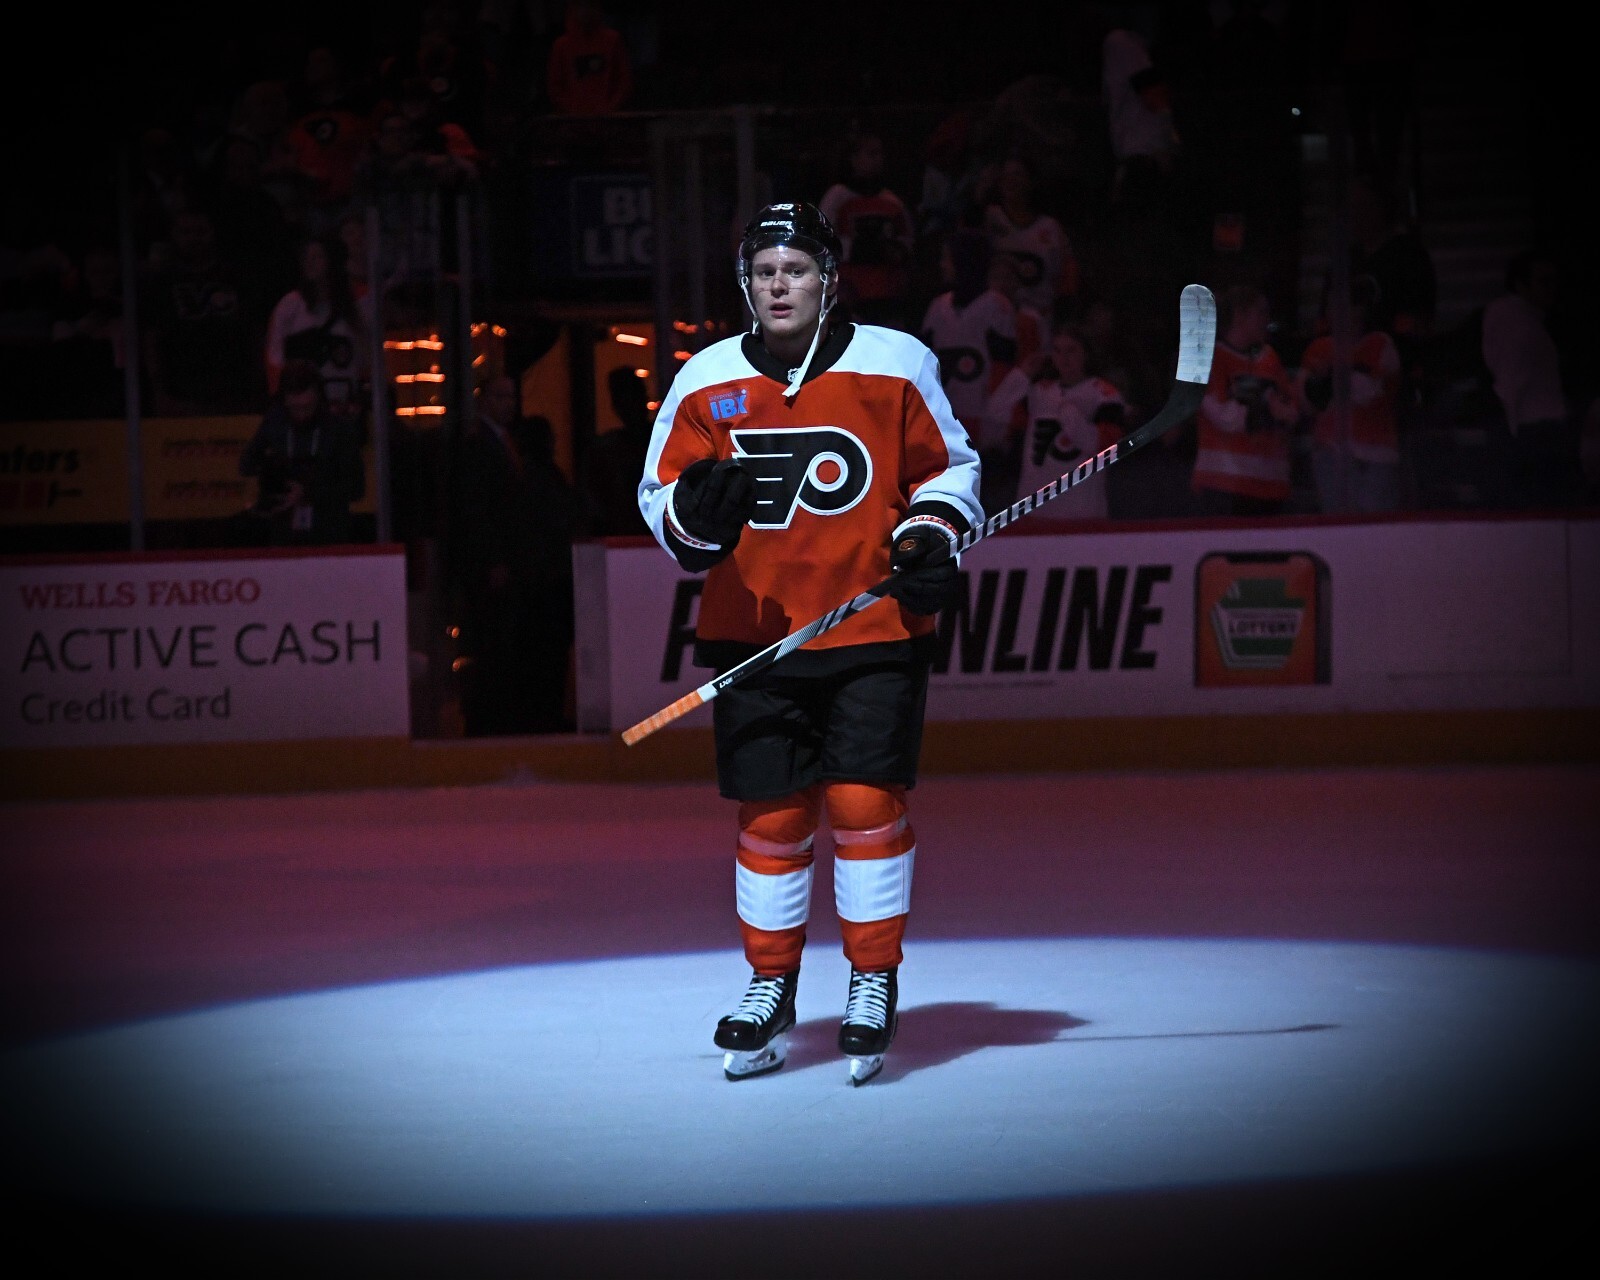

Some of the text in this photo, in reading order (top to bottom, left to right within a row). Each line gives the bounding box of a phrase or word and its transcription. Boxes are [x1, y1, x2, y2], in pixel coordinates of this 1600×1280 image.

[710, 394, 747, 420] IBX
[19, 577, 261, 610] WELLS FARGO
[929, 564, 1171, 673] NLINE
[21, 620, 381, 673] ACTIVE CASH
[20, 687, 231, 724] Credit Card
